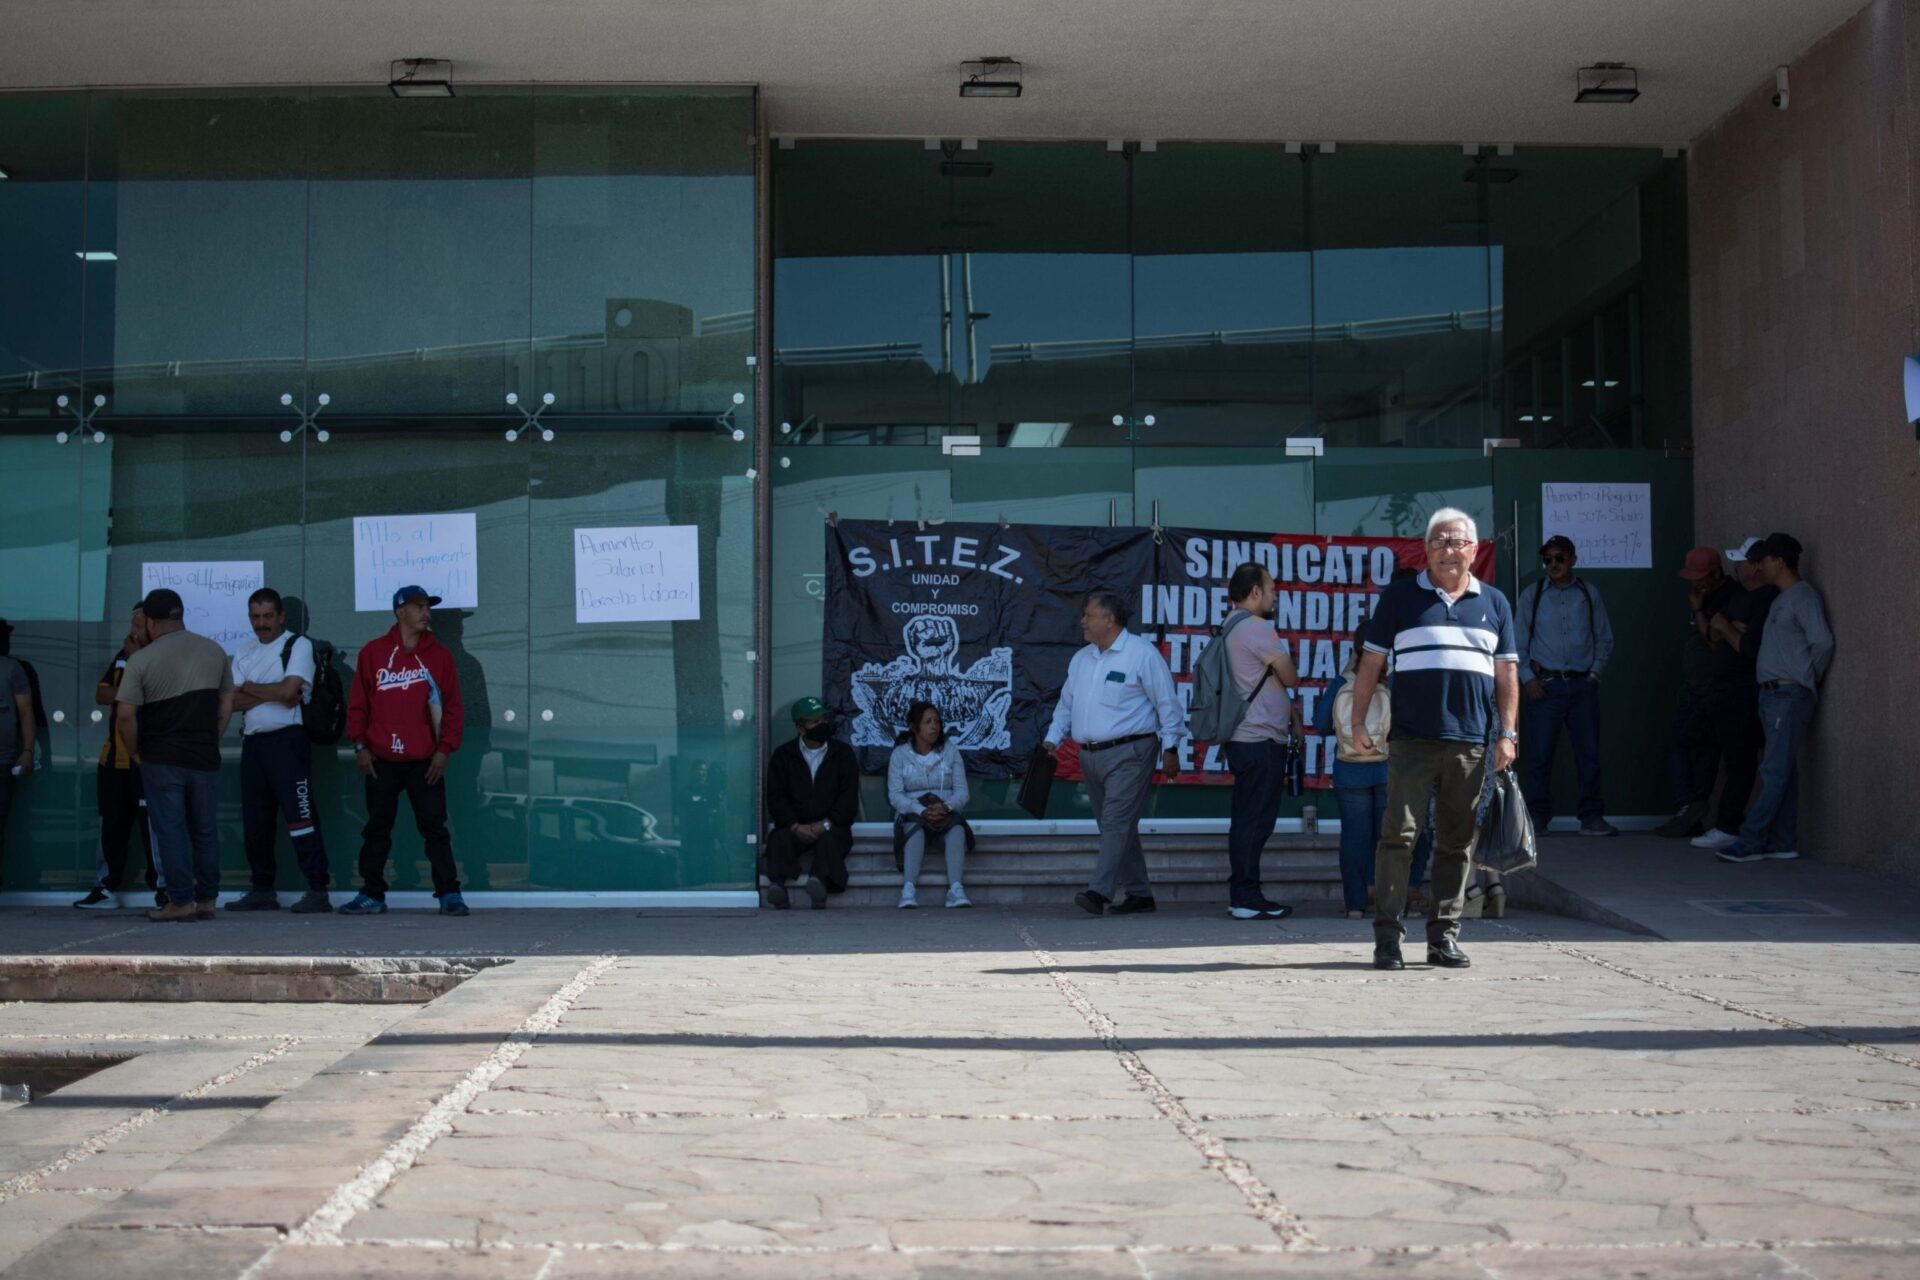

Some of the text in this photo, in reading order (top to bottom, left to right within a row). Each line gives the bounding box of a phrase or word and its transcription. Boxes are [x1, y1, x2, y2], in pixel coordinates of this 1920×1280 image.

[848, 535, 1024, 585] S.I.T.E.Z.
[911, 573, 960, 586] UNIDAD
[931, 588, 940, 600] Y
[891, 601, 979, 616] COMPROMISO
[295, 778, 312, 819] TOMMY
